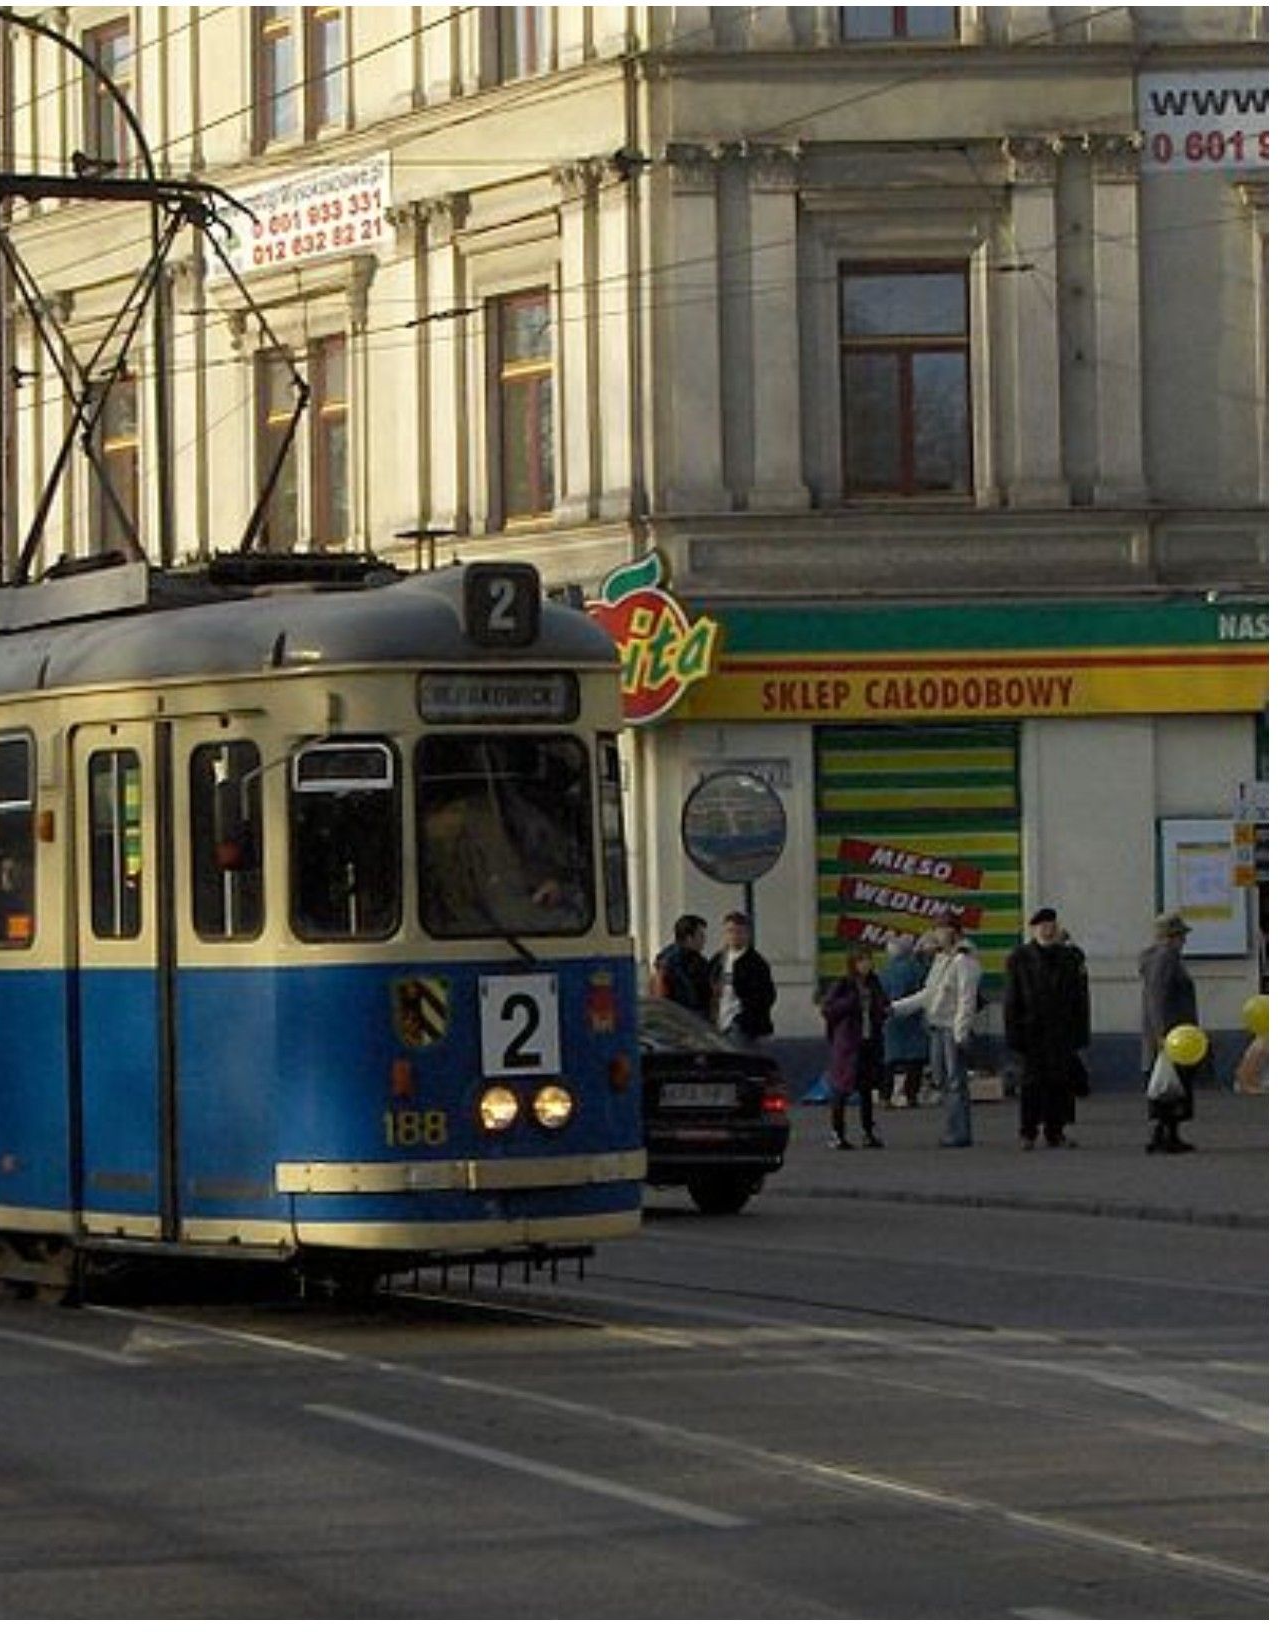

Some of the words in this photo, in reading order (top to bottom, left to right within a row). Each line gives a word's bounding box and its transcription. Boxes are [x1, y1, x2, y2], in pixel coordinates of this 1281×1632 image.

[1152, 133, 1174, 163] 0
[1186, 130, 1244, 161] 601
[349, 189, 382, 214] 331
[253, 240, 286, 265] 012
[361, 217, 383, 241] 21
[487, 578, 516, 630] 2
[620, 606, 717, 694] ita
[762, 679, 850, 712] SKLEP
[865, 675, 1073, 711] CAŁODOBOWY
[500, 993, 543, 1068] 2
[385, 1102, 447, 1147] 188
